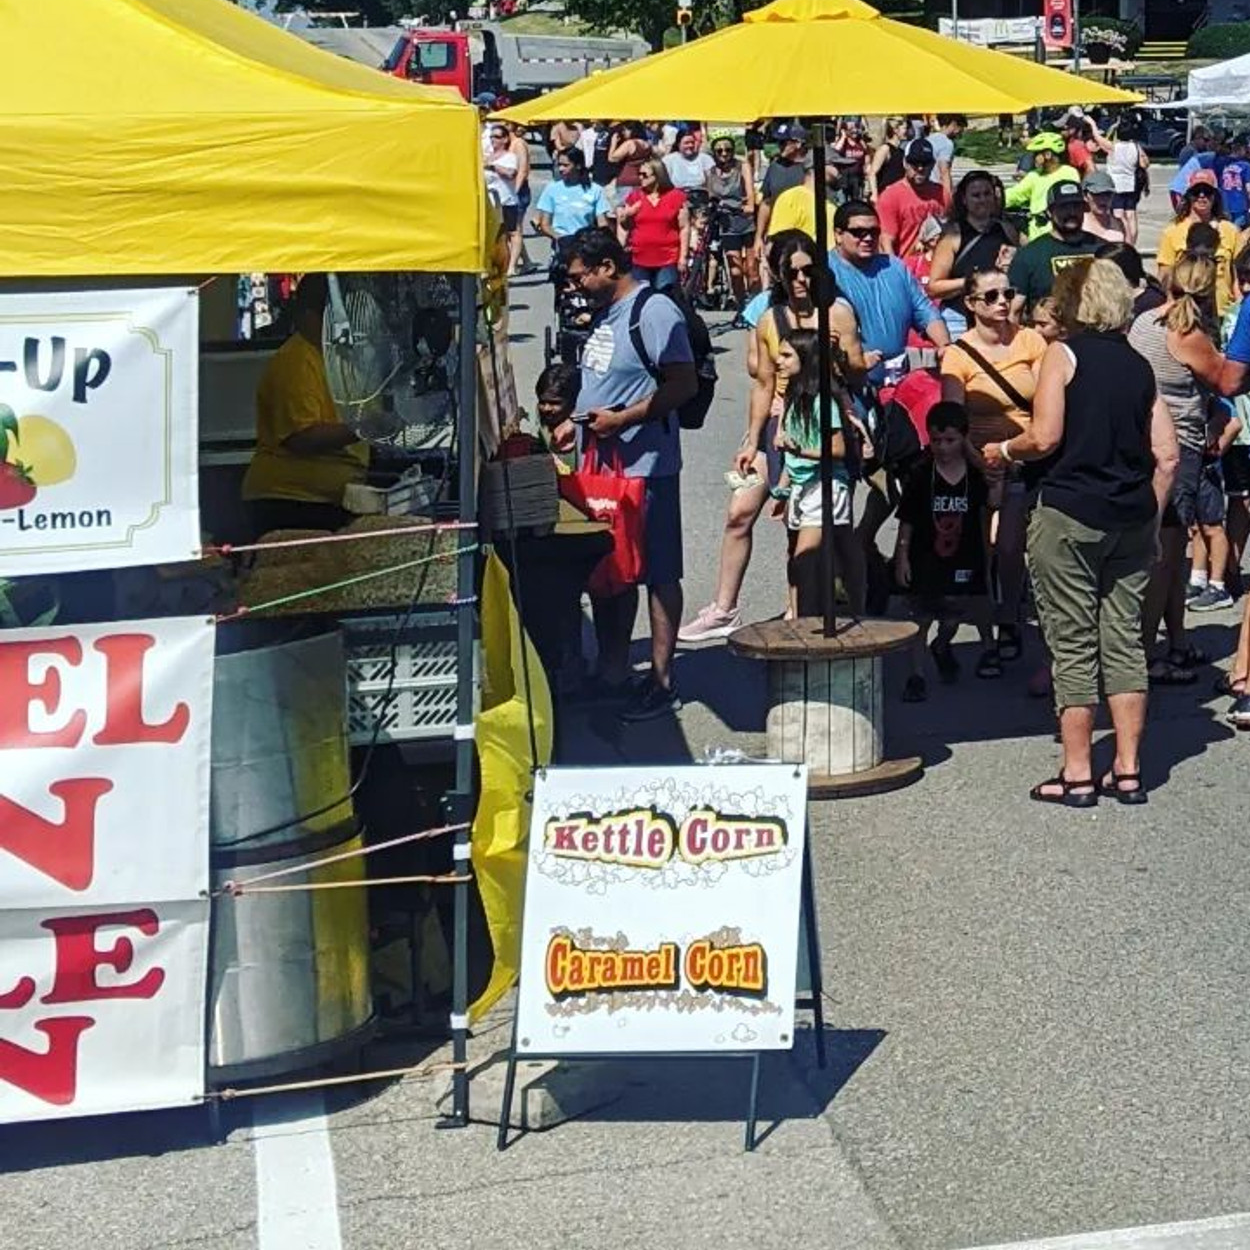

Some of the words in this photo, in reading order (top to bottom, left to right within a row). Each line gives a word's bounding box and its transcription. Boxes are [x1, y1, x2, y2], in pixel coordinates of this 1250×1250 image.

[933, 496, 968, 512] BEARS
[553, 818, 667, 859] Kettle
[686, 817, 776, 856] Corn
[0, 908, 165, 1010] E
[549, 941, 676, 990] Caramel
[687, 944, 763, 988] Corn
